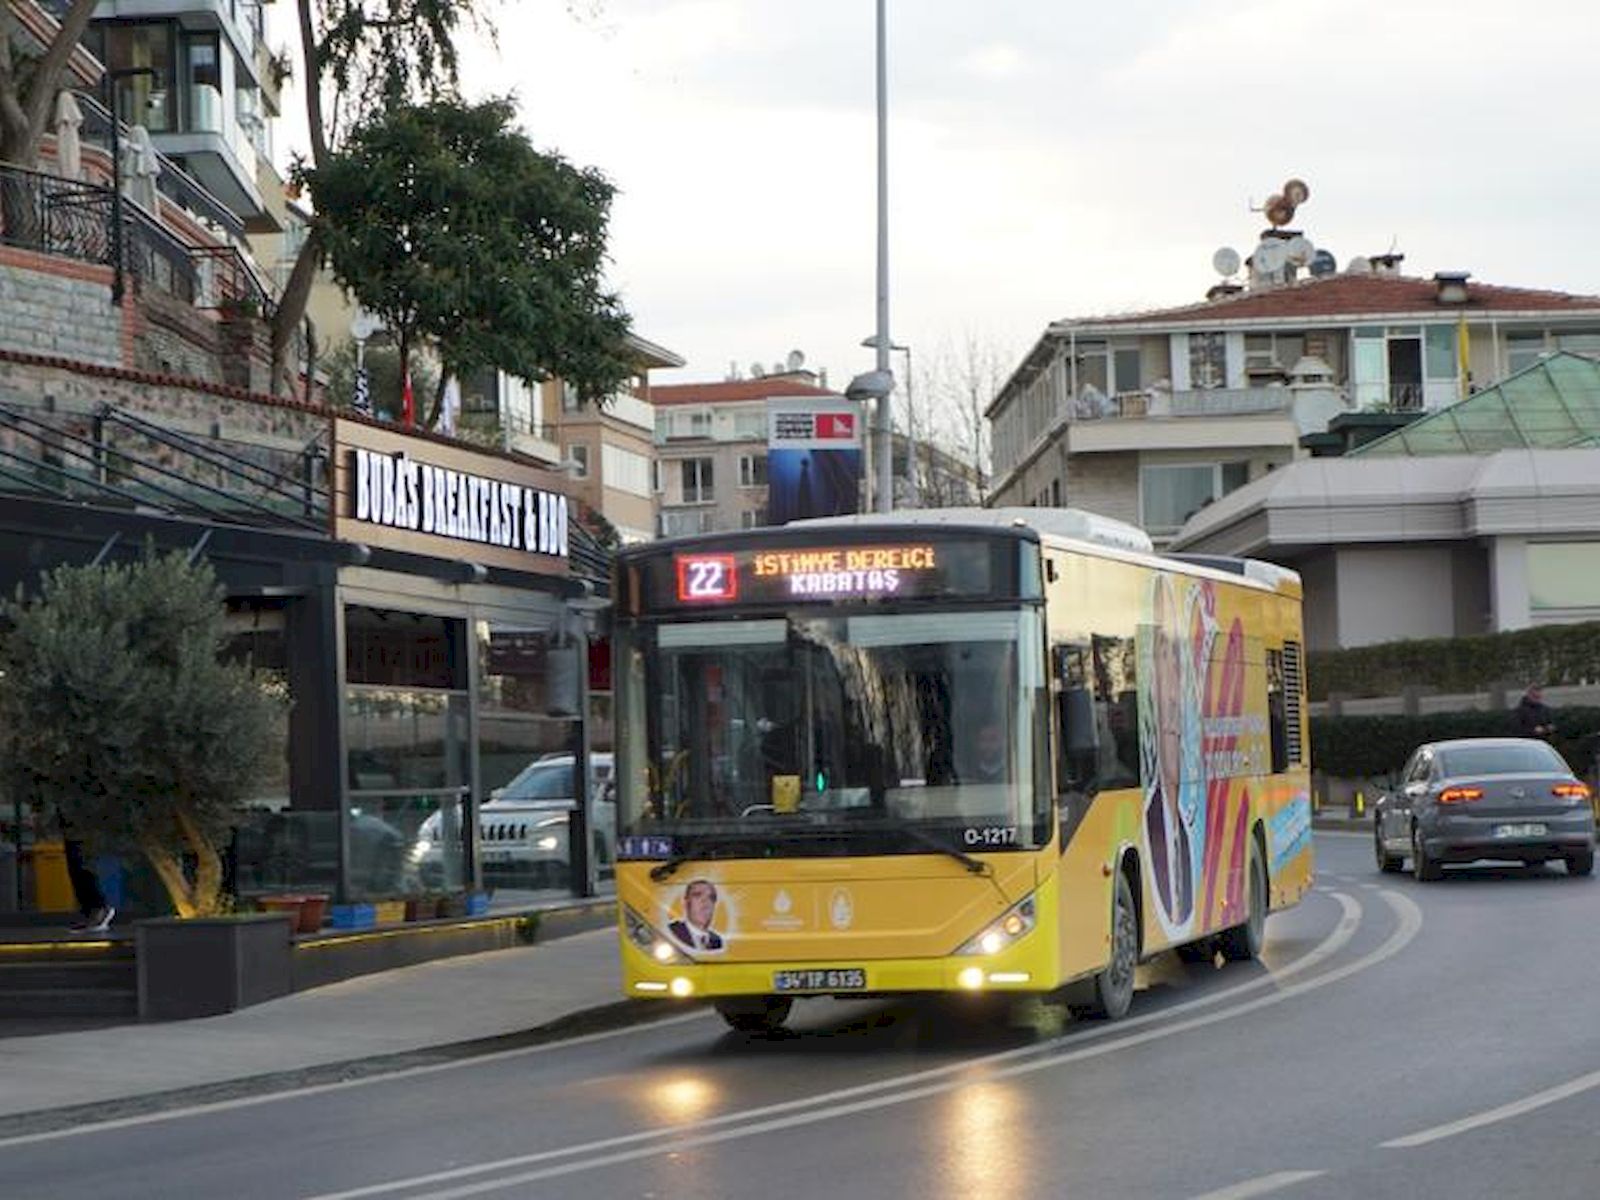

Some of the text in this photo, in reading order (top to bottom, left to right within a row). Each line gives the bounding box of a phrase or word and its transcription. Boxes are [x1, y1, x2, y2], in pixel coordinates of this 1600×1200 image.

[422, 464, 521, 549] BREAKFAST
[524, 488, 537, 551] &
[688, 562, 724, 596] 22
[791, 570, 900, 594] KABATAŞ
